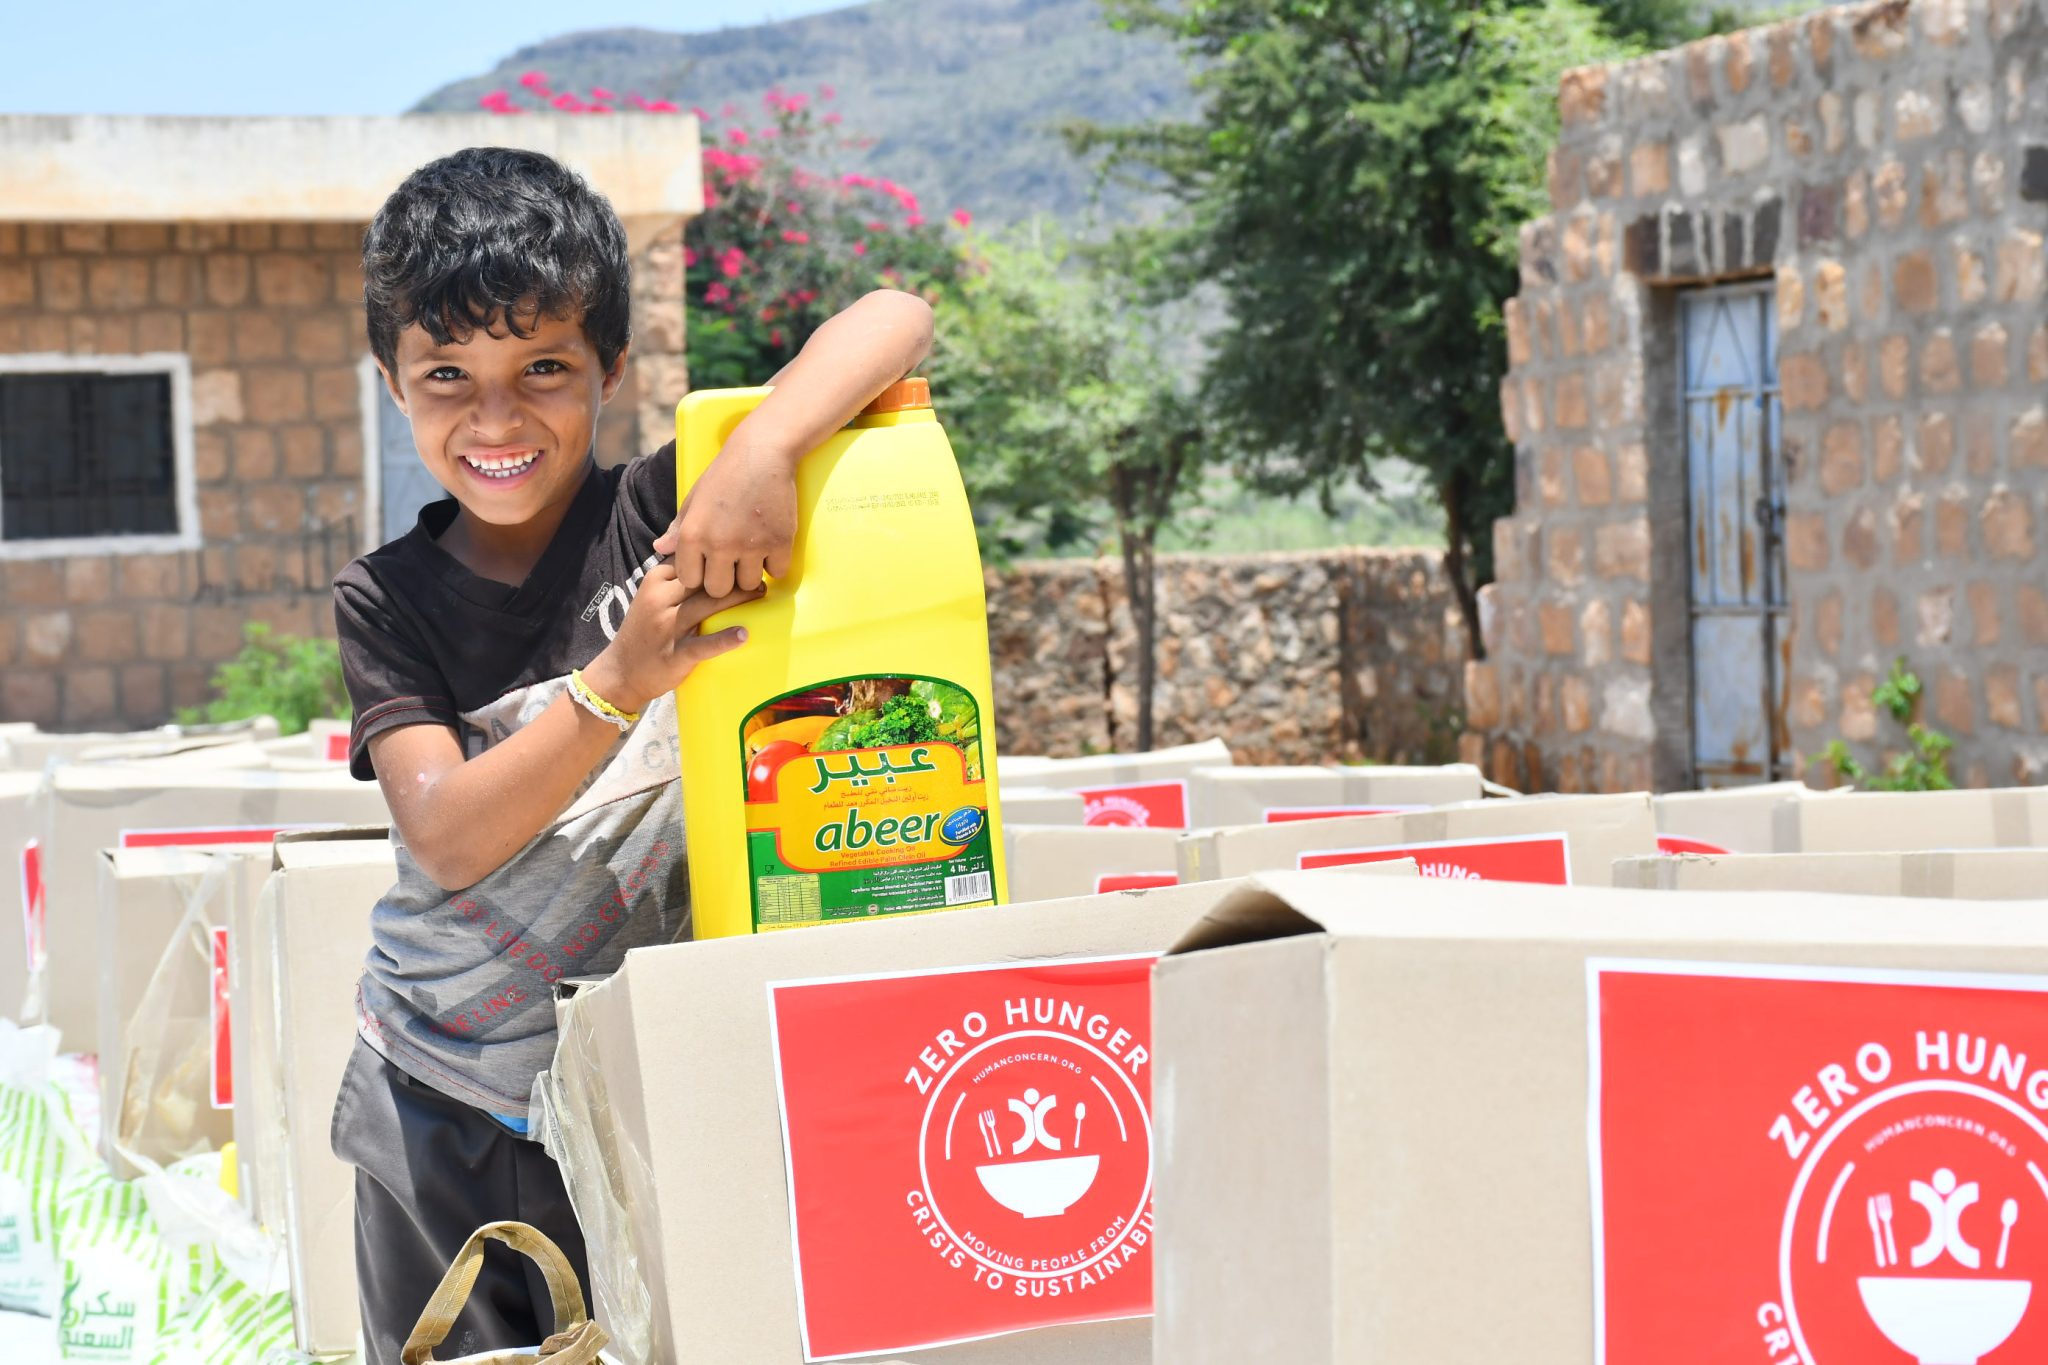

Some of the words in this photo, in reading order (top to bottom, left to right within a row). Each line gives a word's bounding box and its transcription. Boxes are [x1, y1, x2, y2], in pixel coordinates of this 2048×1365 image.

[810, 747, 937, 794] عبير
[815, 809, 941, 852] abeer
[829, 858, 857, 868] Refined
[858, 857, 879, 865] Edible
[916, 850, 926, 859] Oil
[840, 849, 875, 859] Vegetable
[877, 846, 904, 856] Cooking
[950, 865, 956, 873] 4
[905, 1011, 987, 1095] ZERO
[1005, 997, 1149, 1075] HUNGER
[972, 1053, 1083, 1084] HUMANCONCERN.ORG
[1768, 1042, 1892, 1160] ZERO
[1864, 1114, 2017, 1158] HUMANCONCERN.ORG
[906, 1190, 966, 1269] CRISIS
[973, 1264, 1004, 1291] TO
[962, 1230, 1025, 1270] MOVING
[1031, 1248, 1088, 1271] PEOPLE
[1089, 1215, 1126, 1258] FROM
[81, 1290, 136, 1325] سكر
